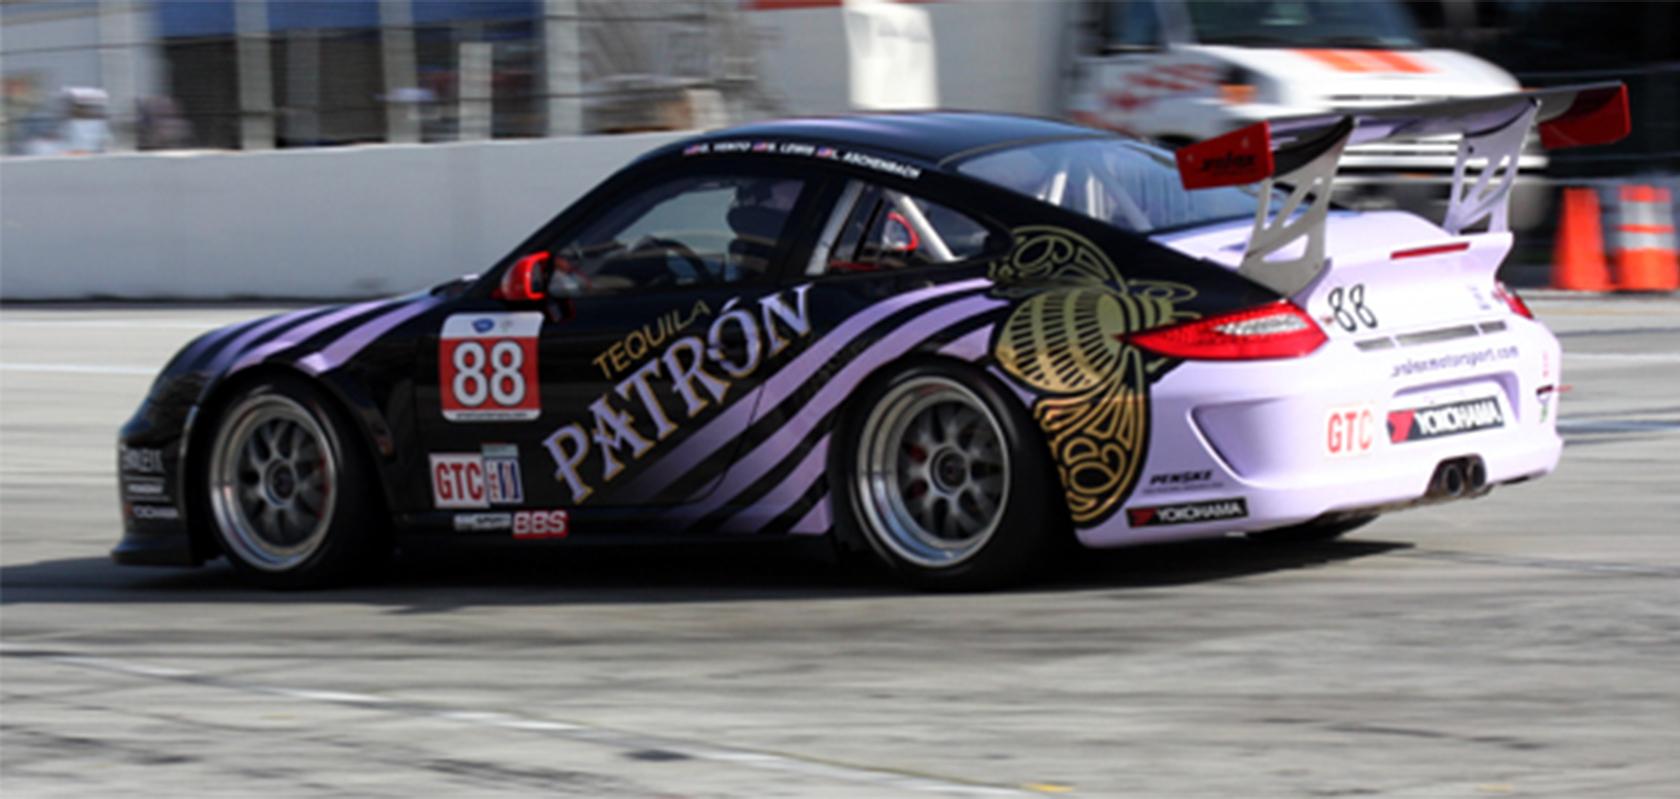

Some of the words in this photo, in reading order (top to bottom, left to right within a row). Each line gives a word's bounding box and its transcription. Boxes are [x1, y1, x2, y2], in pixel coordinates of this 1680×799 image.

[780, 142, 816, 156] LEWIS
[843, 152, 921, 178] ASCHENBACH
[1327, 282, 1378, 332] 88
[593, 299, 711, 380] TEQUILA
[453, 341, 526, 406] 88
[542, 284, 814, 505] PATRÓN
[1327, 410, 1372, 454] GTC
[1414, 399, 1503, 436] YOKOHAMA
[434, 462, 484, 501] GTC
[1149, 469, 1213, 485] PENSKE
[512, 510, 567, 534] BBS
[1156, 501, 1243, 523] YOKOHAMA
